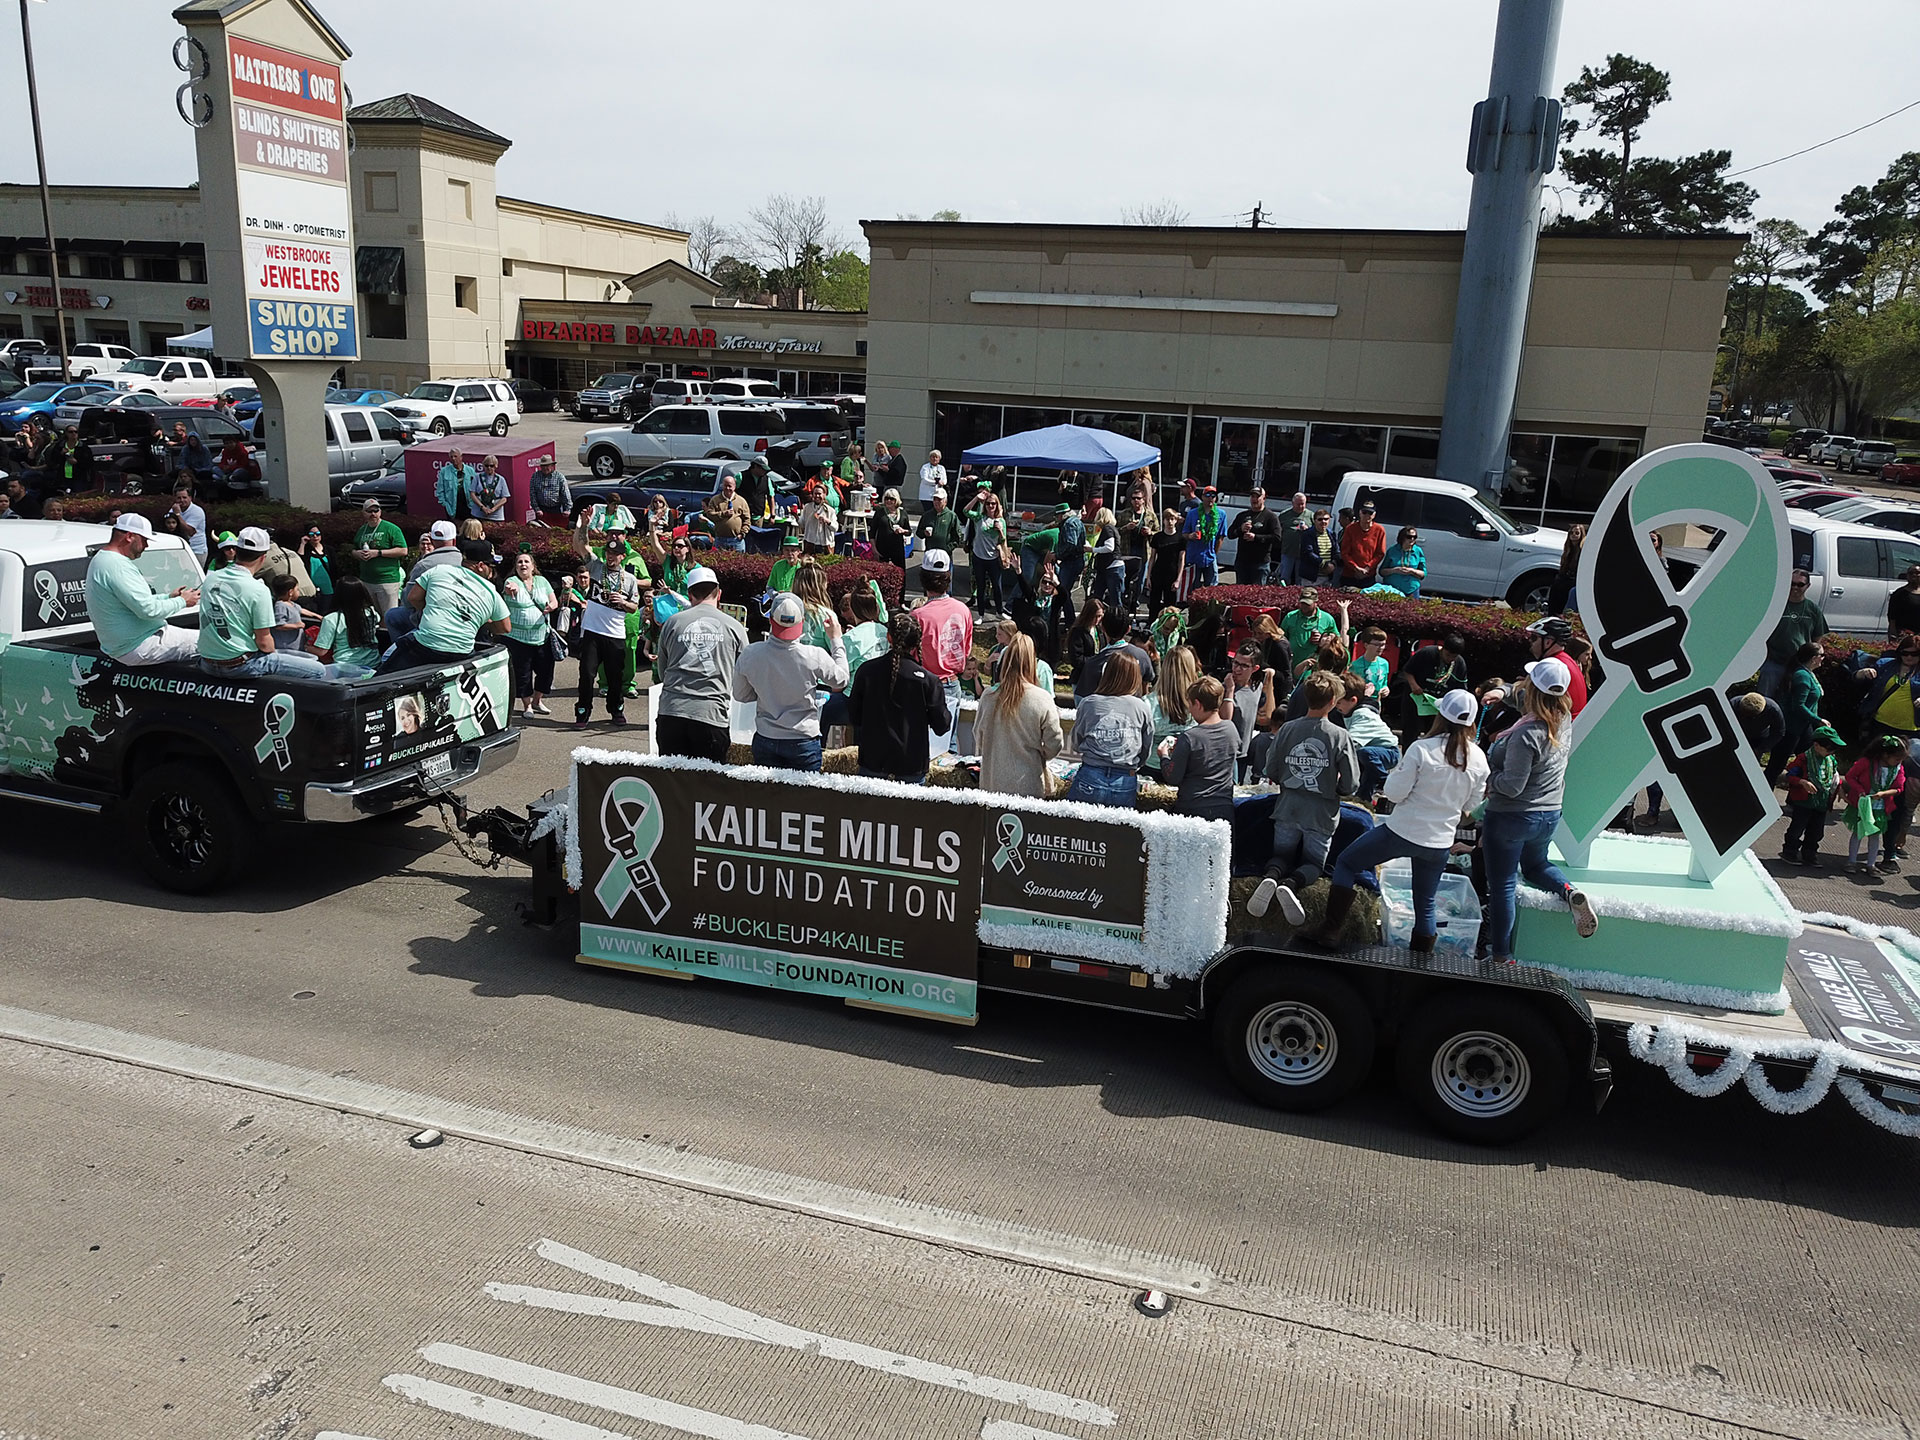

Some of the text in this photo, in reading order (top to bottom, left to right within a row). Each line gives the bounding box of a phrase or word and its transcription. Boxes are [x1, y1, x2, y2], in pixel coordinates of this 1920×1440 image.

[233, 53, 300, 95] MATTRESS
[310, 74, 336, 104] ONE
[238, 107, 340, 151] BLINDS SHUTTERS
[256, 140, 329, 175] & DRAPERIES
[246, 217, 260, 228] DR.
[264, 219, 284, 231] DINH
[293, 223, 346, 239] OPTOMETRIST
[265, 244, 331, 265] WESTBROOKE
[260, 264, 340, 293] JEWELERS
[257, 301, 347, 330] SMOKE
[270, 328, 339, 354] SHOP
[523, 320, 716, 348] BIZARRE BAZAAR
[720, 335, 821, 353] Mercury Travel
[112, 673, 258, 704] #BUCKLEUP4KAILEE
[388, 734, 454, 761] #BUCKLEUP4KAILEE
[694, 801, 961, 873] KAILEE MILLS
[1027, 833, 1107, 855] KAILEE MILLS
[1026, 849, 1106, 868] FOUNDATION
[693, 857, 956, 922] FOUNDATION
[1022, 880, 1104, 909] Sponsored by
[692, 913, 905, 959] #BUCKLEUP4KAILEE
[597, 935, 956, 1004] WWW.KAILEEMILLSFOUNDATION.ORG
[1799, 949, 1872, 1023] KAILEE MILLS
[1838, 957, 1911, 1031] FOUNDATION
